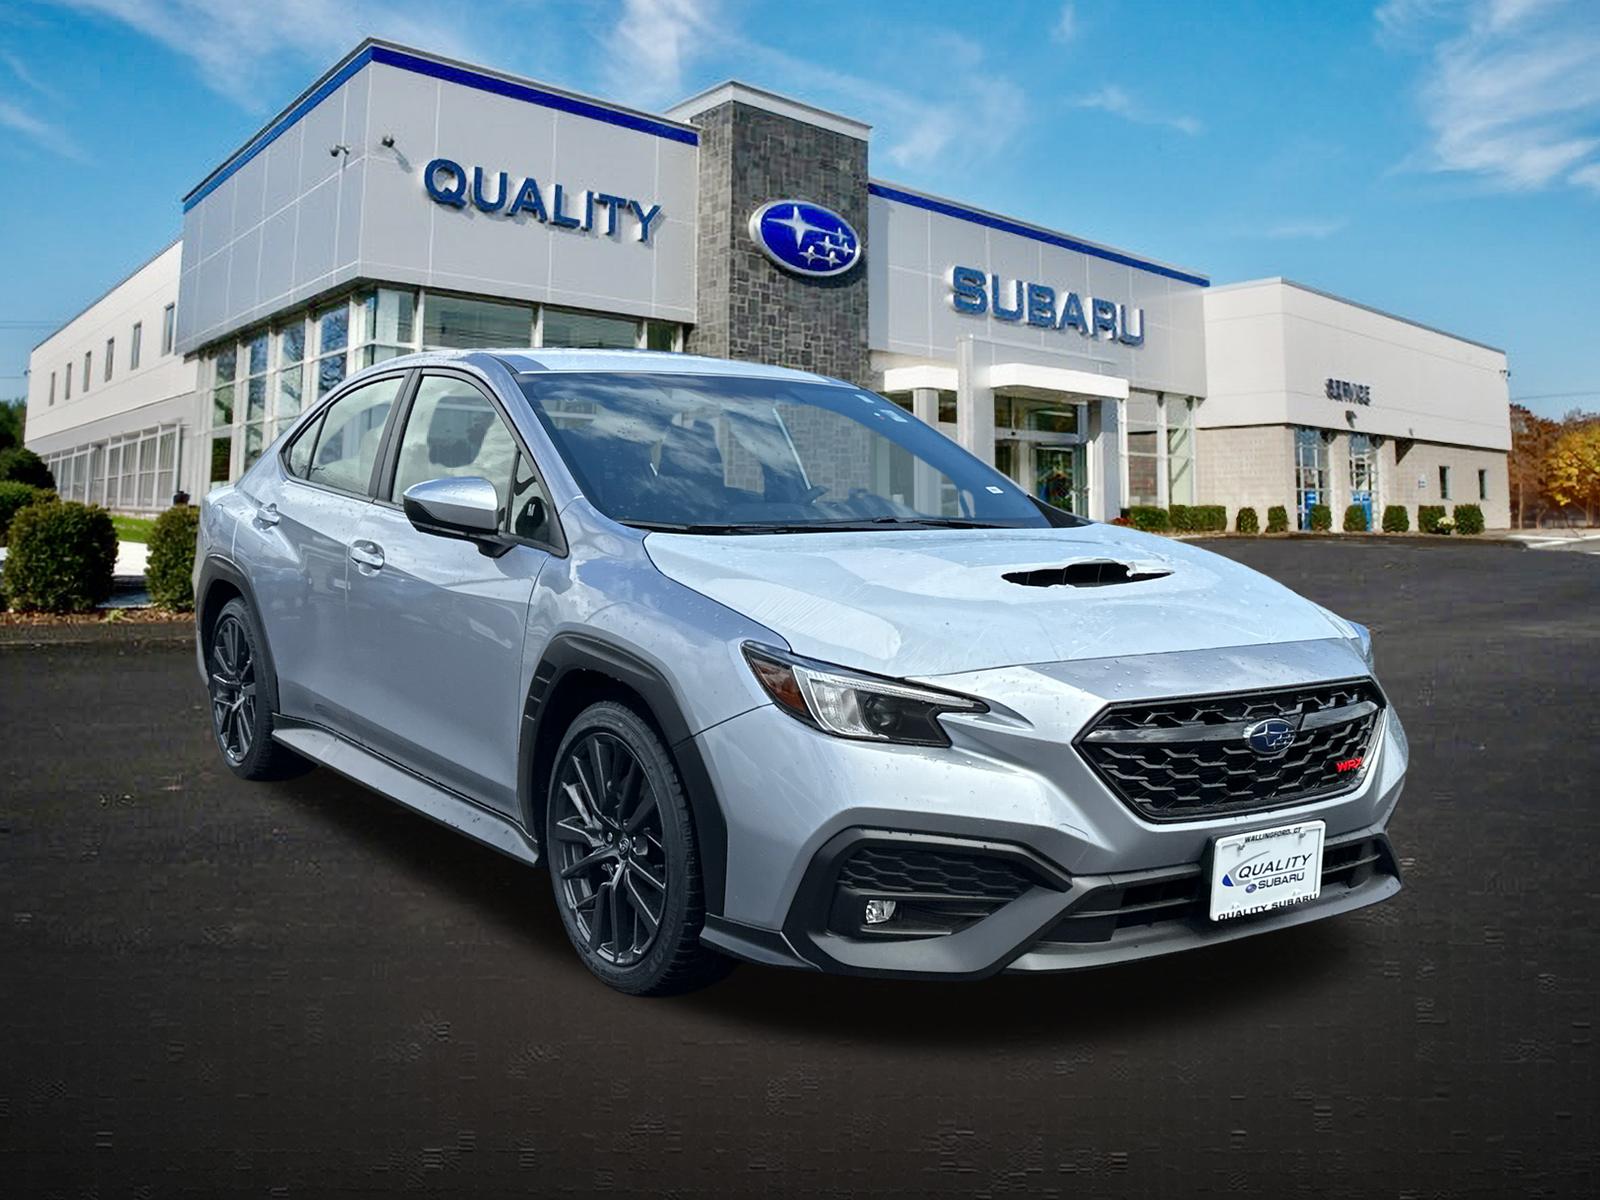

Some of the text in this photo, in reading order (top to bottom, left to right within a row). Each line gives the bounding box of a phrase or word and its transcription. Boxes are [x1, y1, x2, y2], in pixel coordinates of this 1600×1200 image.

[423, 158, 662, 242] QUALITY
[949, 265, 1144, 346] SUBARU
[1325, 378, 1371, 406] SERVICE
[1336, 757, 1362, 772] WRX
[1238, 853, 1312, 879] QUALITY
[1258, 872, 1305, 890] SUBARU
[1217, 893, 1317, 921] QUALITY SUBARU
